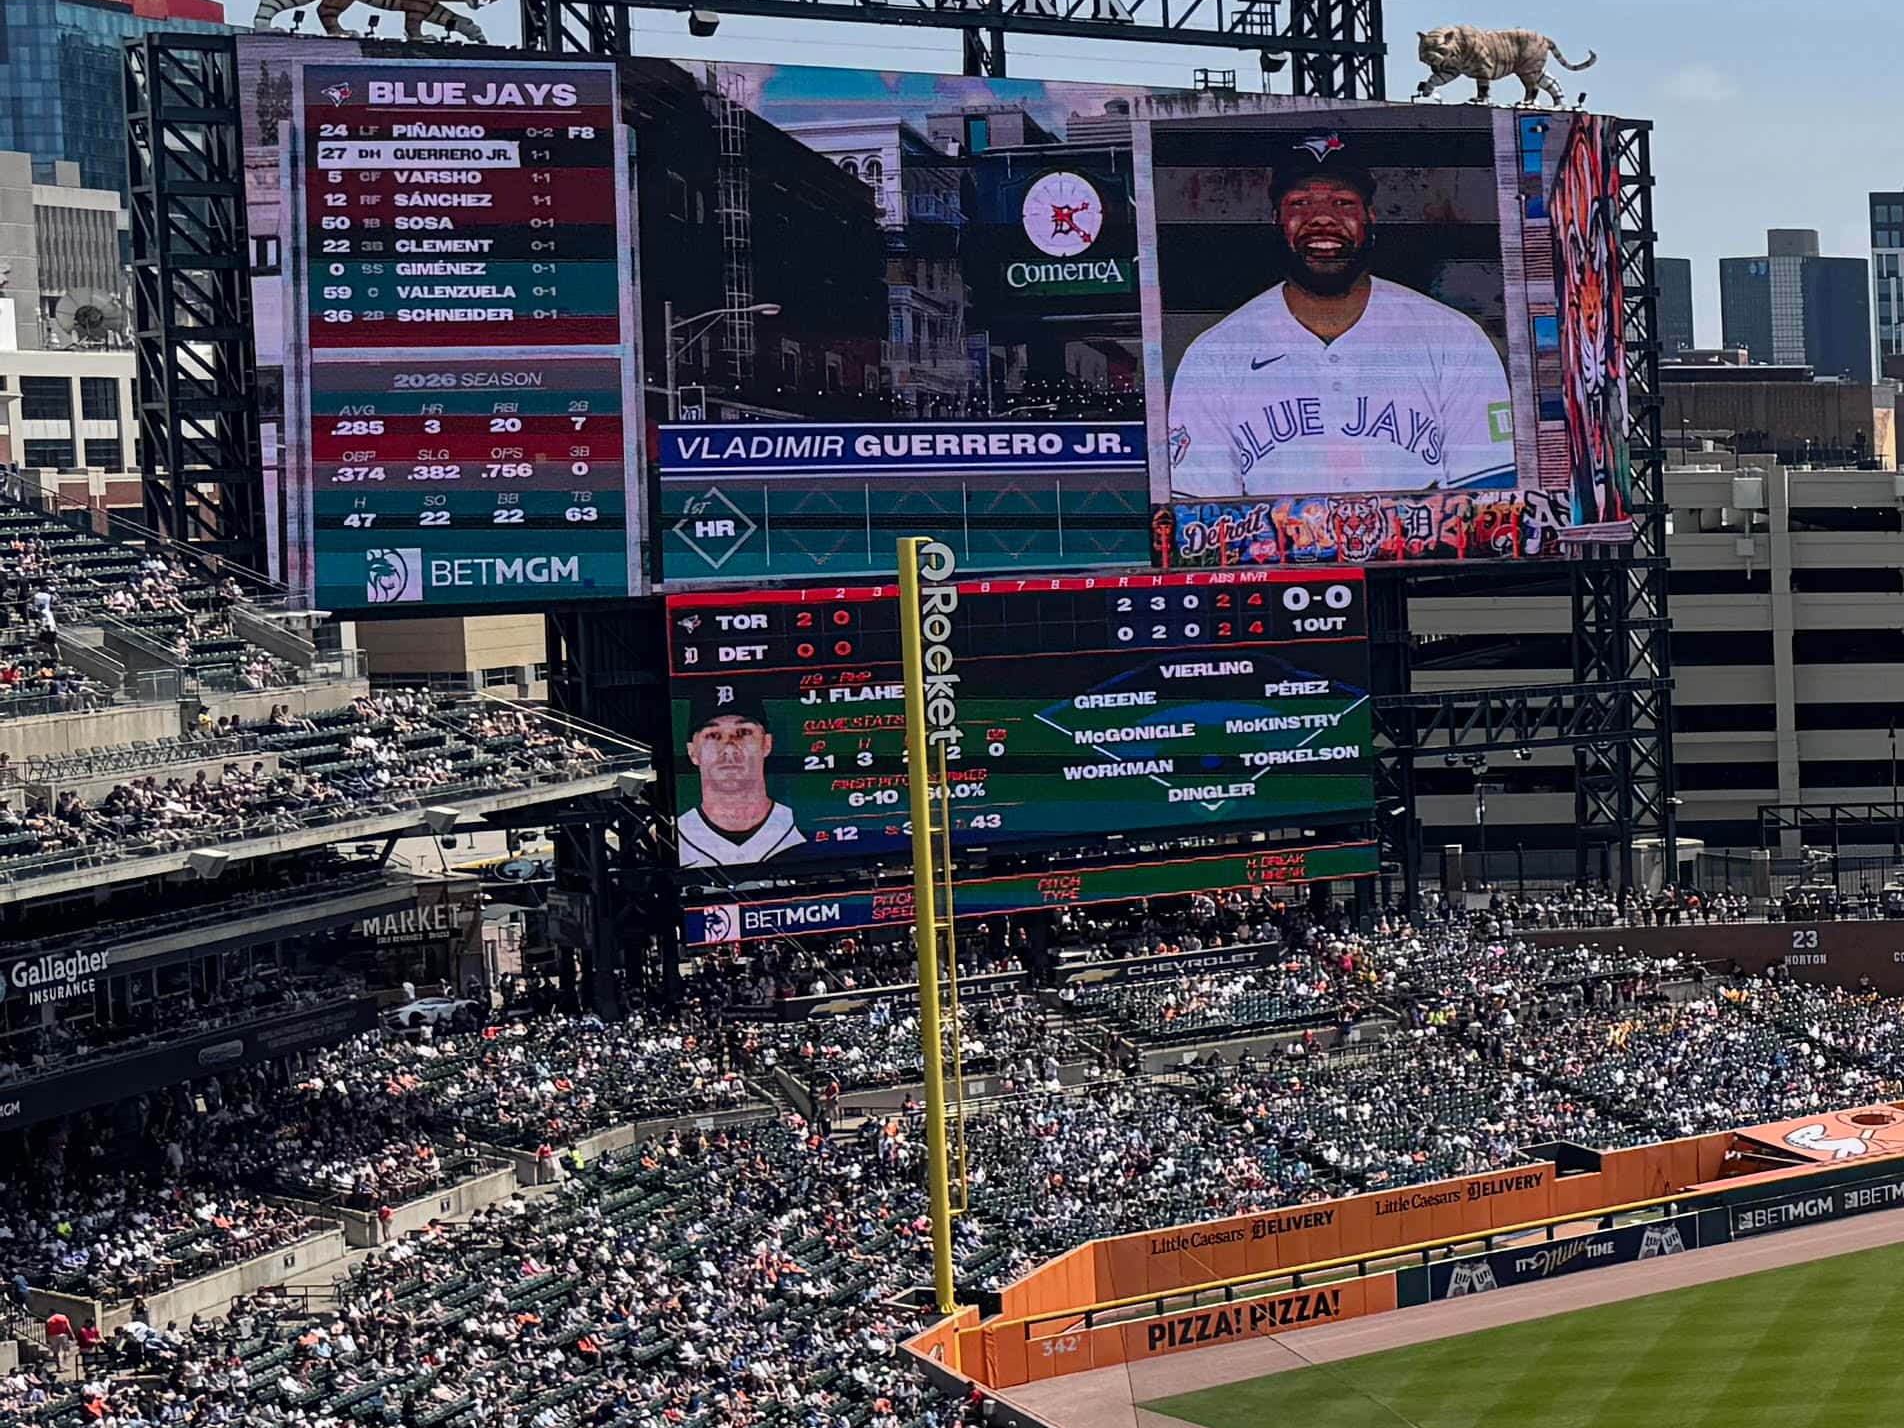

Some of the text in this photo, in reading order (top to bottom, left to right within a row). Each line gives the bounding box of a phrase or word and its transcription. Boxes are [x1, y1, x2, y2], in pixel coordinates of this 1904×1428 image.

[368, 81, 577, 107] BLUE JAYS
[392, 122, 485, 138] PIÑANGO
[321, 148, 511, 161] 27 GUERRERO JR.
[393, 172, 482, 184] VARSHO
[394, 191, 492, 206] SÁNCHEZ
[395, 217, 453, 230] SOSA
[322, 240, 493, 253] 22 CLEMENT
[329, 260, 486, 276] 0 GIMÉNEZ
[323, 286, 516, 299] 59 VALENZUELA
[323, 309, 514, 322] 36 SCHNEIDER
[394, 372, 542, 388] 2026 SEASON
[339, 404, 375, 416] AVG
[331, 418, 522, 436] .285 20
[1341, 396, 1442, 466] JAYS
[417, 447, 523, 460] SLG OPS
[677, 433, 1132, 461] VLADIMIR GUERRERO JR.
[331, 463, 533, 482] .374 .382 .756
[343, 507, 597, 527] 47 22 22 63
[695, 519, 735, 537] HR
[1181, 503, 1270, 558] Detroit
[431, 555, 579, 587] BETMGM
[1283, 585, 1352, 610] 0-0
[716, 614, 768, 630] TOR
[719, 646, 768, 661] DET
[922, 586, 965, 746] Rocket
[1160, 661, 1254, 678] VIERLING
[1265, 679, 1329, 697] PÉREZ
[1074, 691, 1157, 709] GREENE
[1075, 723, 1196, 744] McGONIGLE
[1225, 714, 1341, 734] McKINSTRY
[1240, 746, 1360, 767] TORKELSON
[1063, 759, 1174, 781] WORKMAN
[849, 790, 898, 806] 6-10
[1168, 782, 1256, 803] DINGLER
[363, 903, 463, 938] MARKET
[745, 903, 840, 929] BETMGM
[1792, 930, 1819, 949] 23
[12, 948, 111, 989] Gallagher
[1127, 952, 1258, 975] CHEVROLET
[29, 978, 96, 1005] INSURANCE
[1375, 1173, 1543, 1216] Little Caesars DELIVERY
[1754, 1195, 1834, 1228] BETMGM
[1152, 1210, 1335, 1255] Little Caesars DELIVERY
[1536, 1237, 1595, 1276] Miller
[1586, 1241, 1616, 1259] TIME
[1149, 1289, 1341, 1351] PIZZA! PIZZA!
